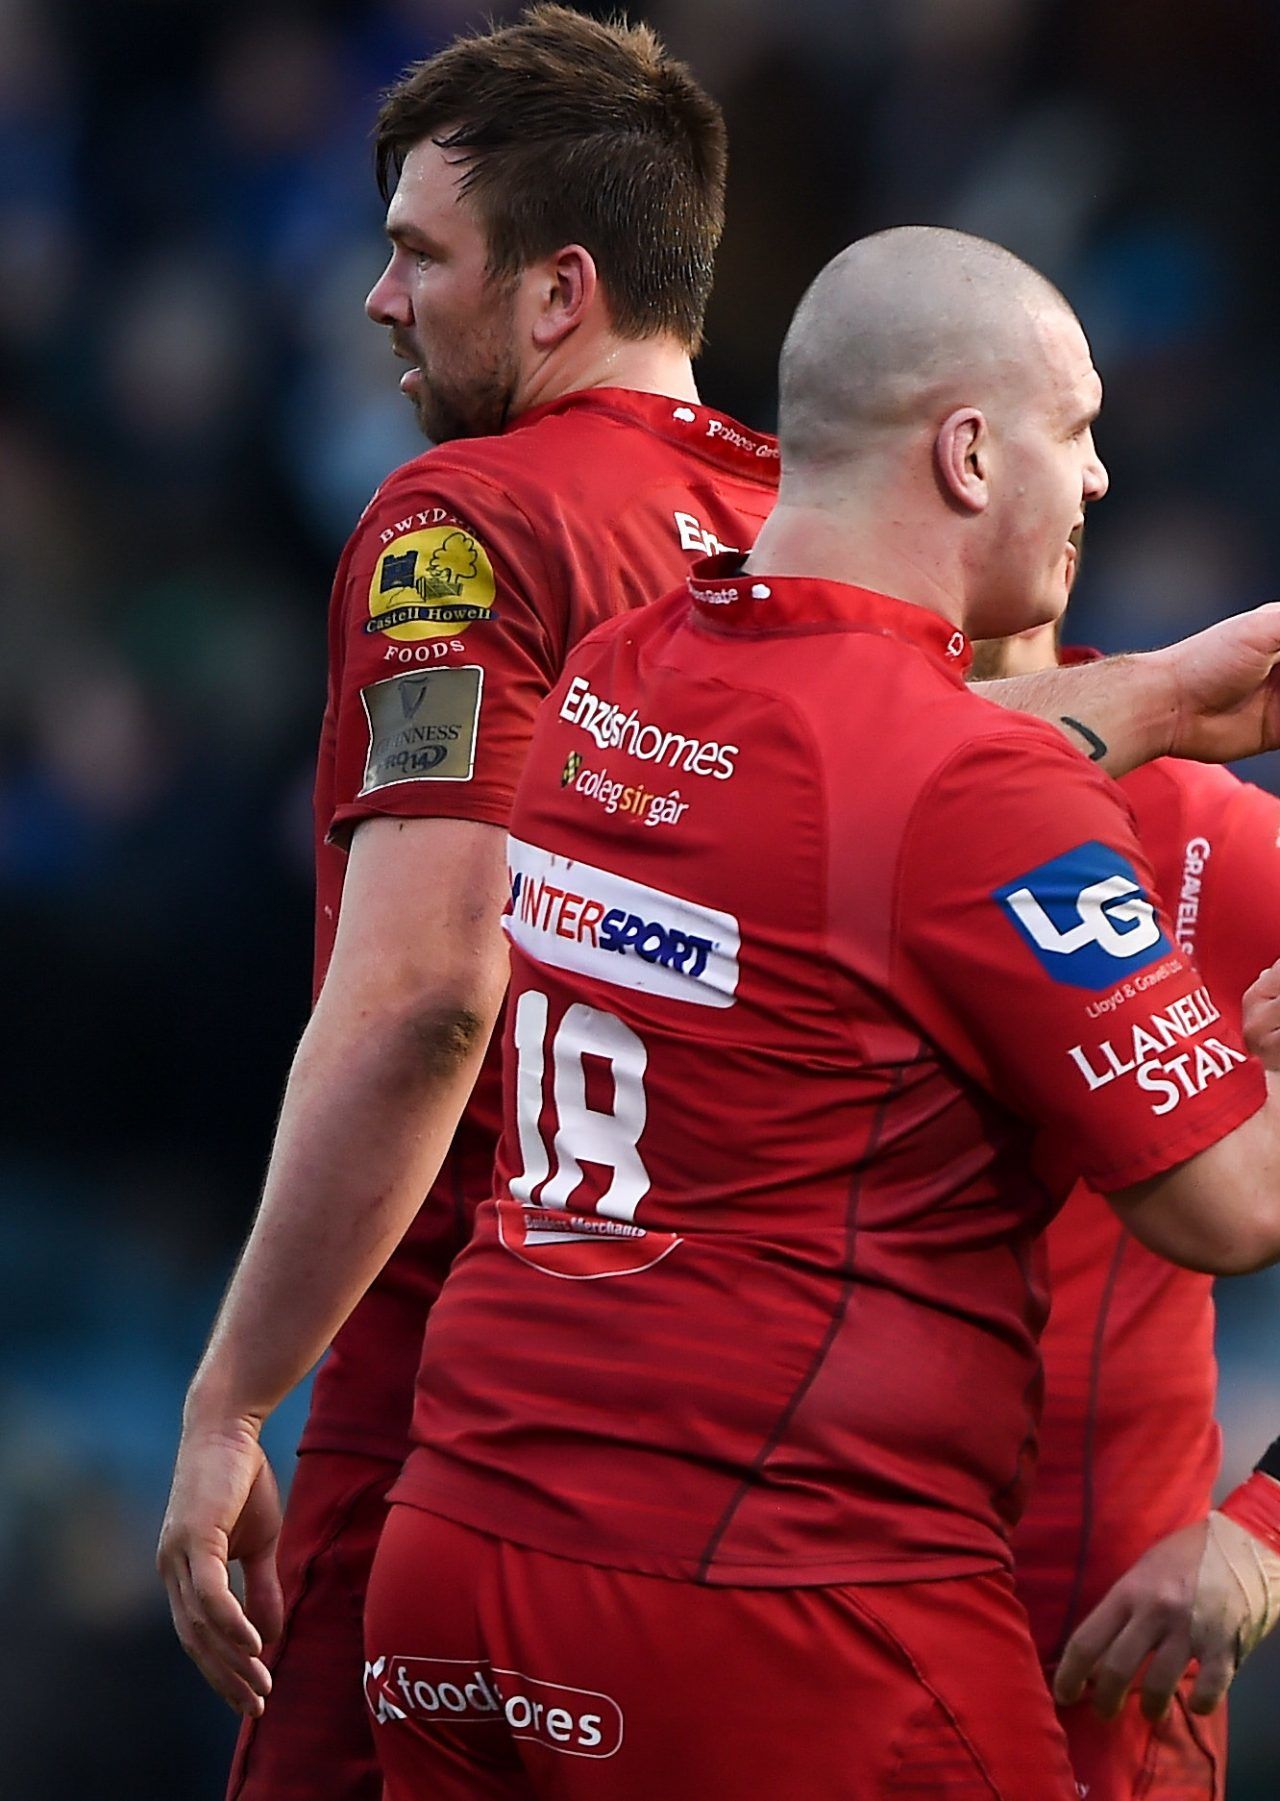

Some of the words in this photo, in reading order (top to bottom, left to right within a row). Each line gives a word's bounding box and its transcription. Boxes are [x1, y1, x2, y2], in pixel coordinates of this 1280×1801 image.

[366, 607, 419, 633] Castell
[428, 608, 491, 620] Howell
[383, 639, 465, 663] FOODS
[521, 874, 713, 978] INTERSPORT
[1006, 875, 1160, 958] LG
[1085, 990, 1125, 1018] Lloyd
[1121, 983, 1137, 998] &
[508, 990, 651, 1222] 18
